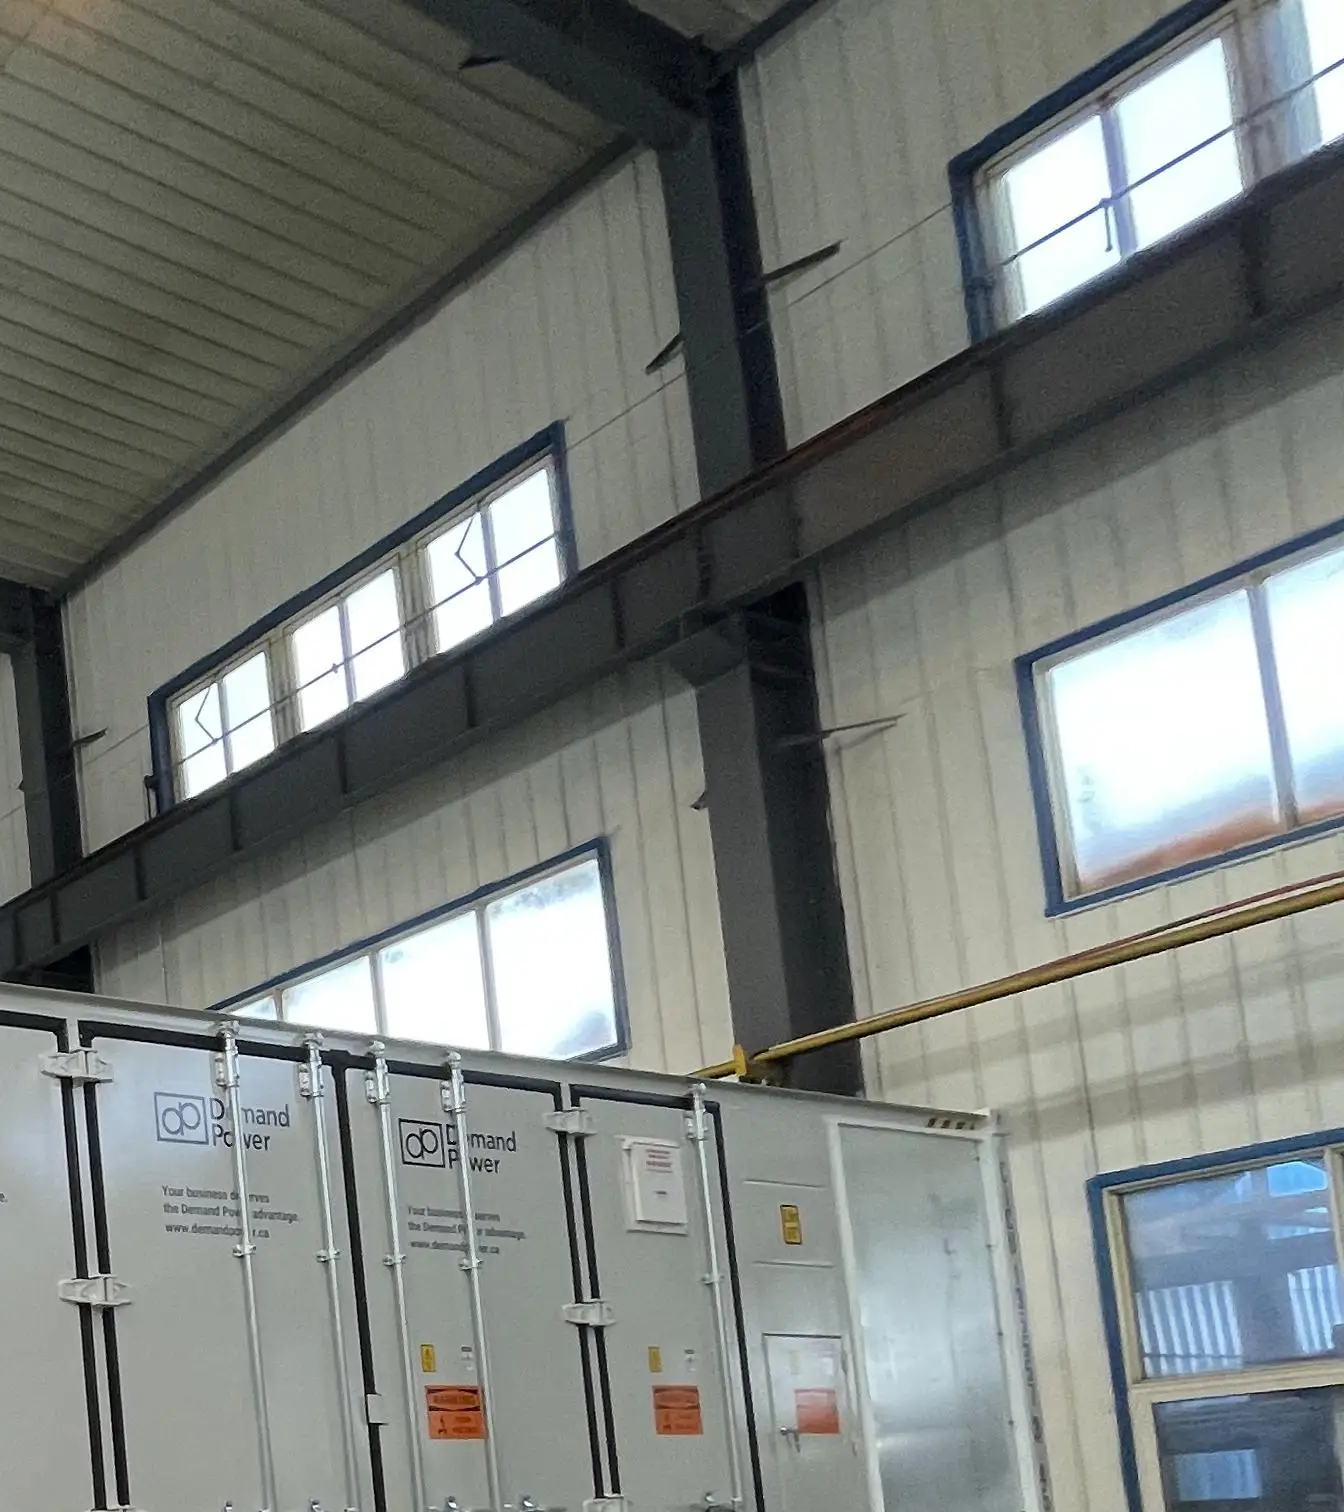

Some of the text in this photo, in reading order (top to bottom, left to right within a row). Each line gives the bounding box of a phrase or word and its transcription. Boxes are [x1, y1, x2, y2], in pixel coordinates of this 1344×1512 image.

[210, 1097, 290, 1127] Dmand
[446, 1123, 516, 1152] Dmand
[448, 1148, 500, 1174] Pwer
